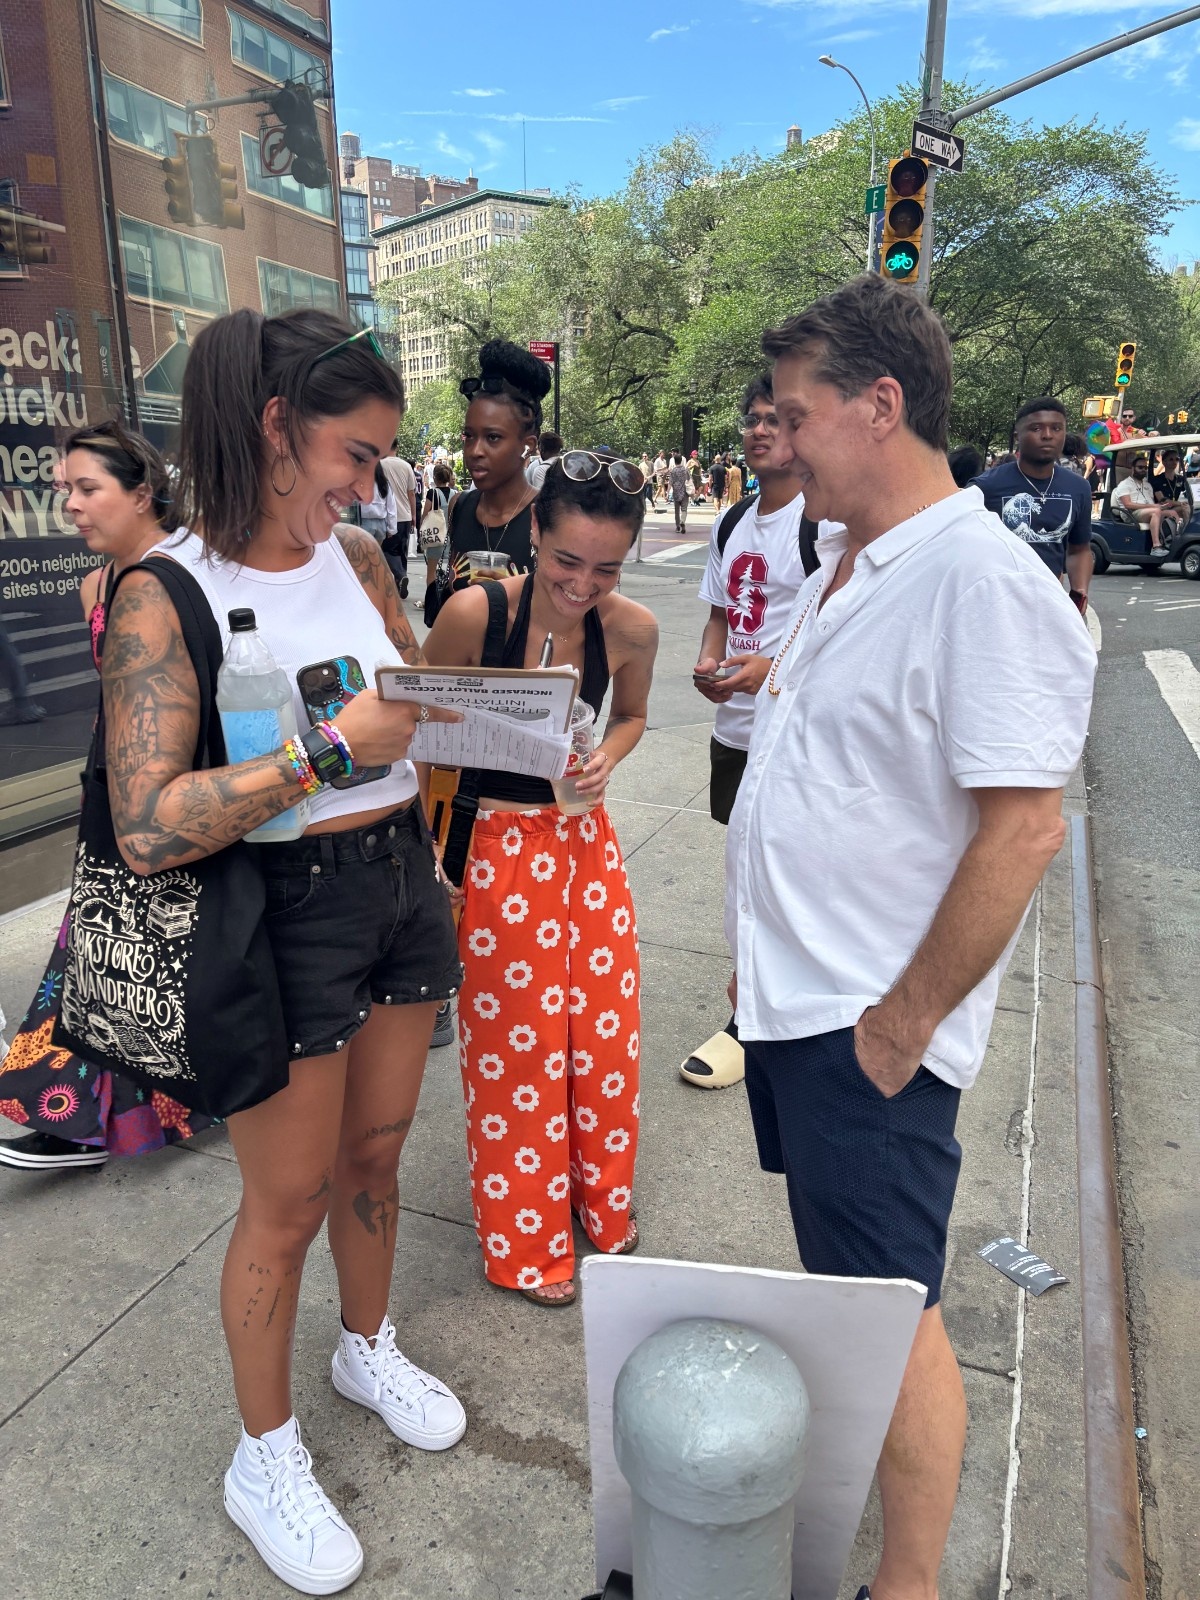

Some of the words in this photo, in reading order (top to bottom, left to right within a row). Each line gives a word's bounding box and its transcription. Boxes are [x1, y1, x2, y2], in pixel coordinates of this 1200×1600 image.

[919, 134, 935, 152] ONE
[941, 142, 957, 159] WAY
[0, 557, 39, 577] 200+
[2, 581, 38, 600] sites
[39, 579, 54, 595] to
[57, 575, 80, 595] get
[434, 697, 526, 706] INITIATIVES
[76, 954, 171, 1027] WANDERER
